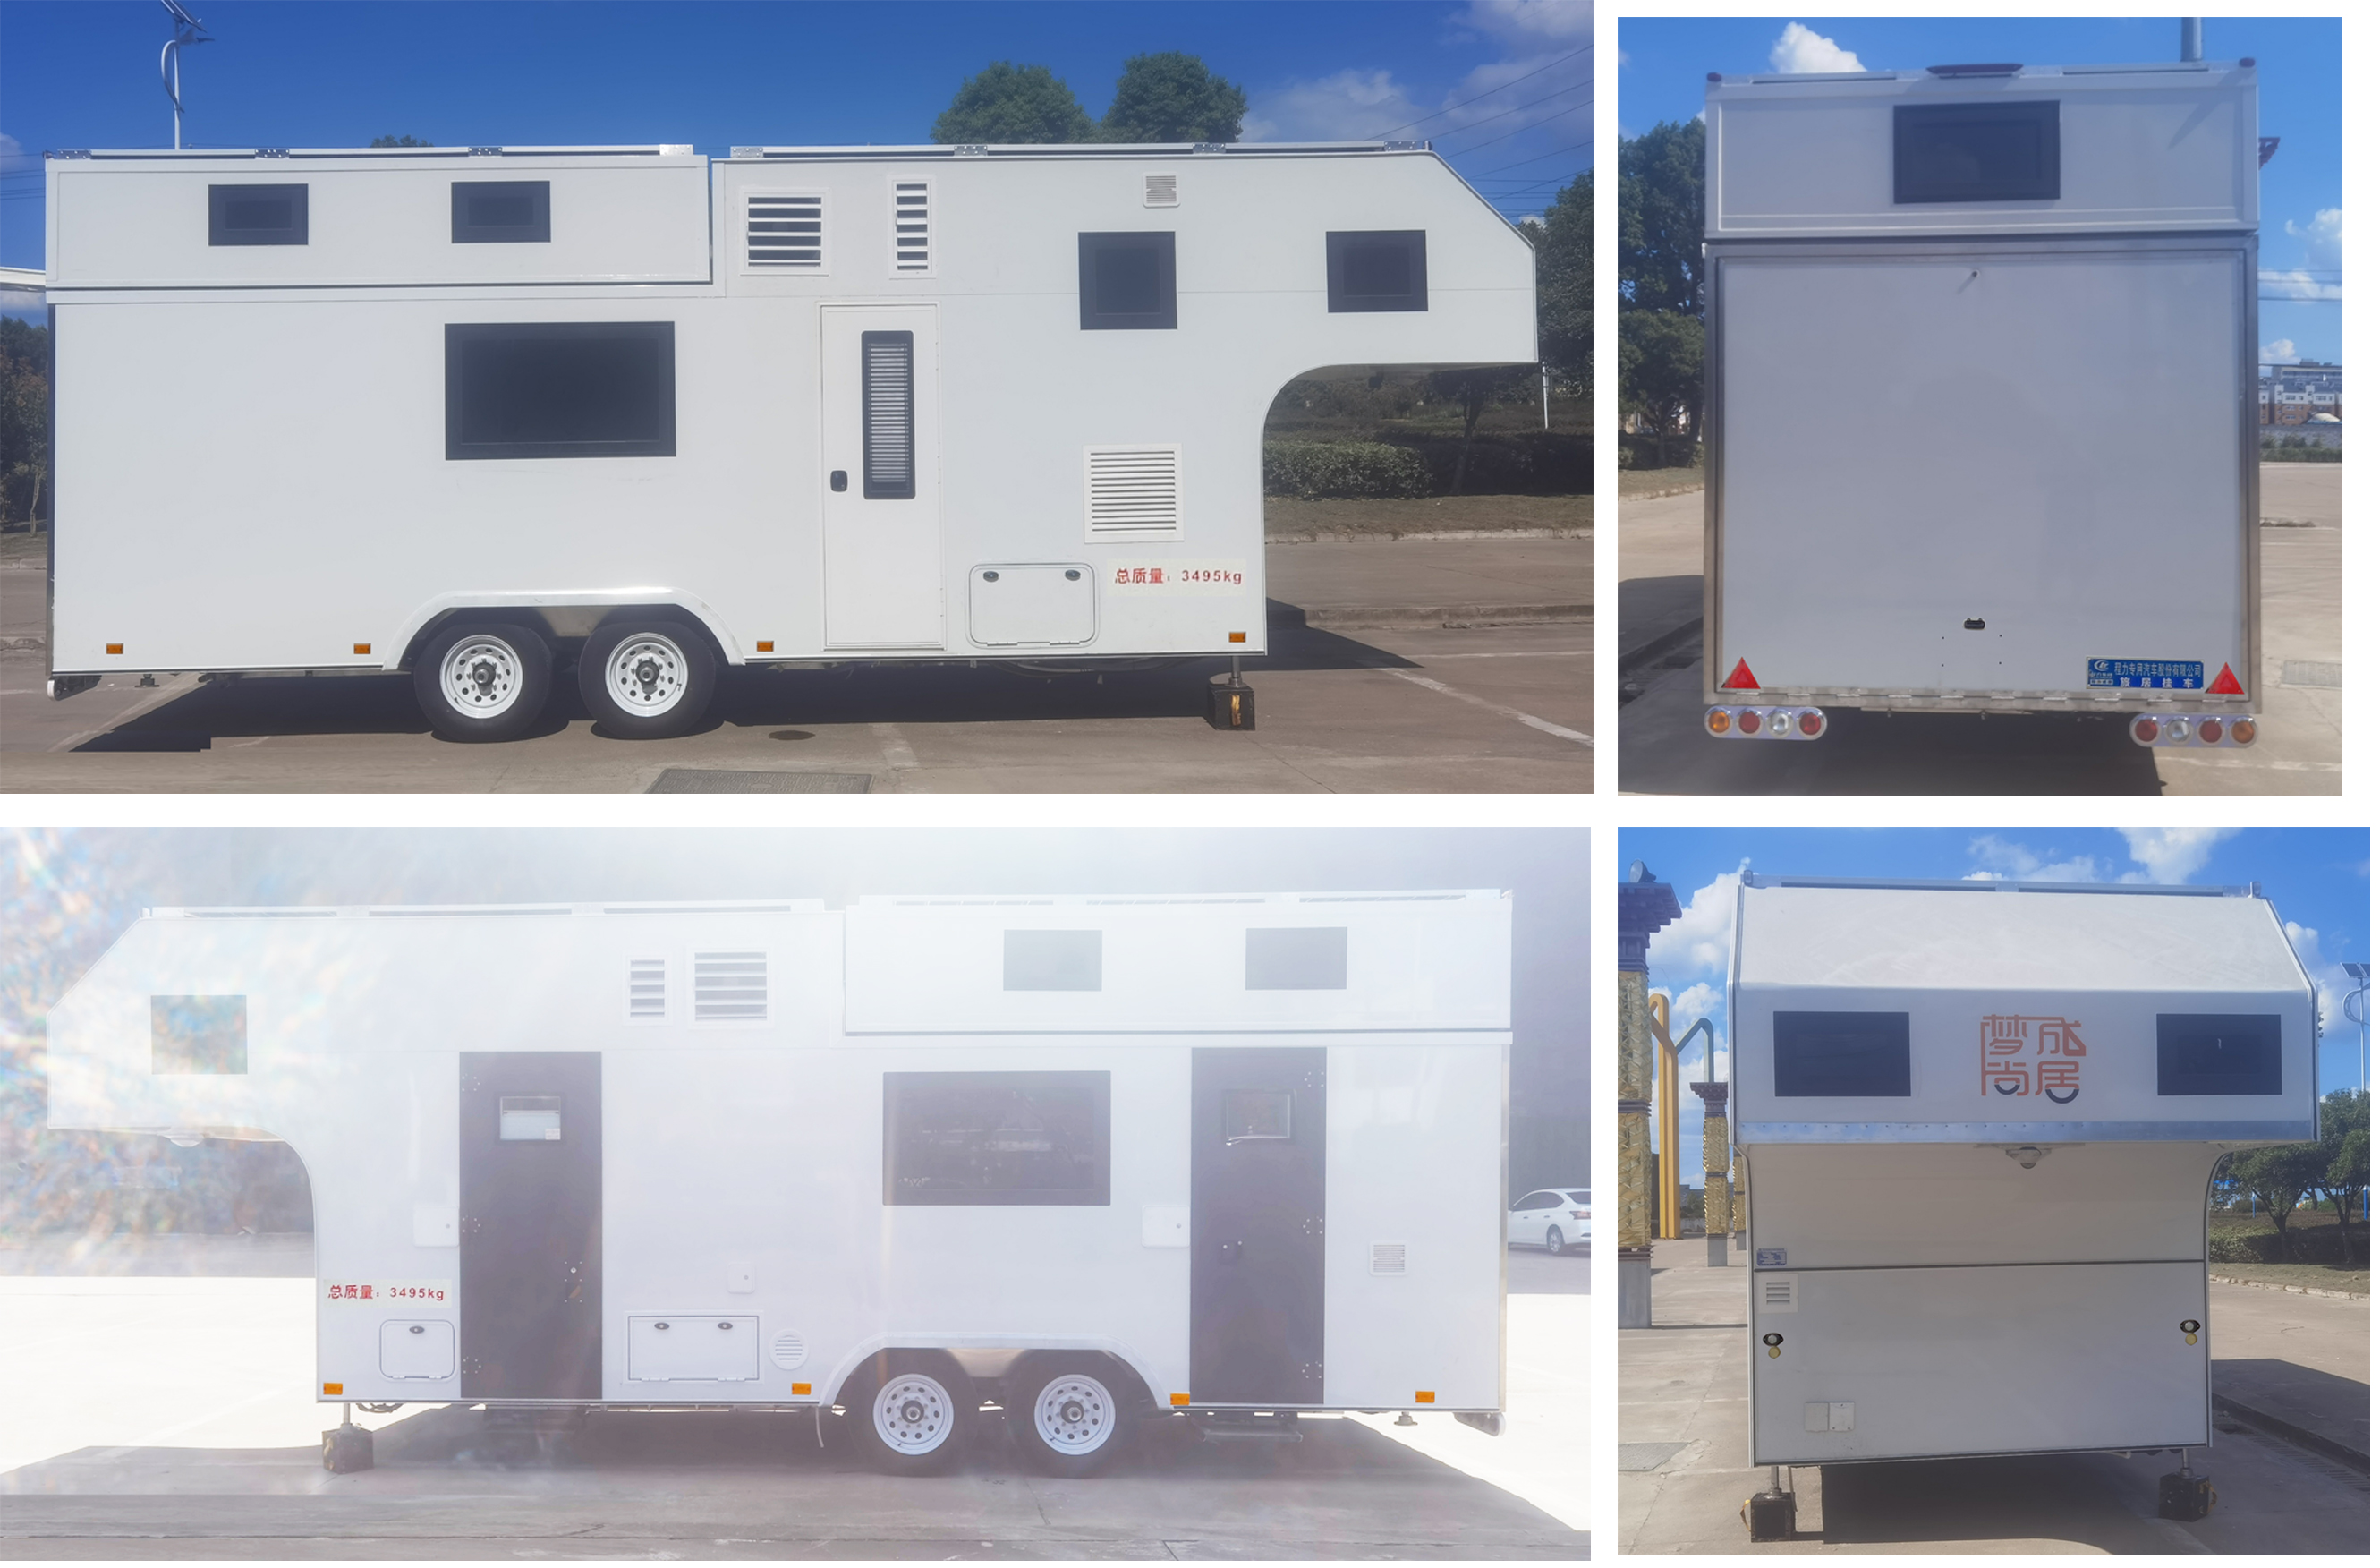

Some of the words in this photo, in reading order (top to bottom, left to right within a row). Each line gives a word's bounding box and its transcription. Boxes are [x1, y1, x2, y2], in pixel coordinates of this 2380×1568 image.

[2114, 662, 2201, 677] 程力专用汽车股份有限公司
[2120, 677, 2194, 688] 旅居挂车
